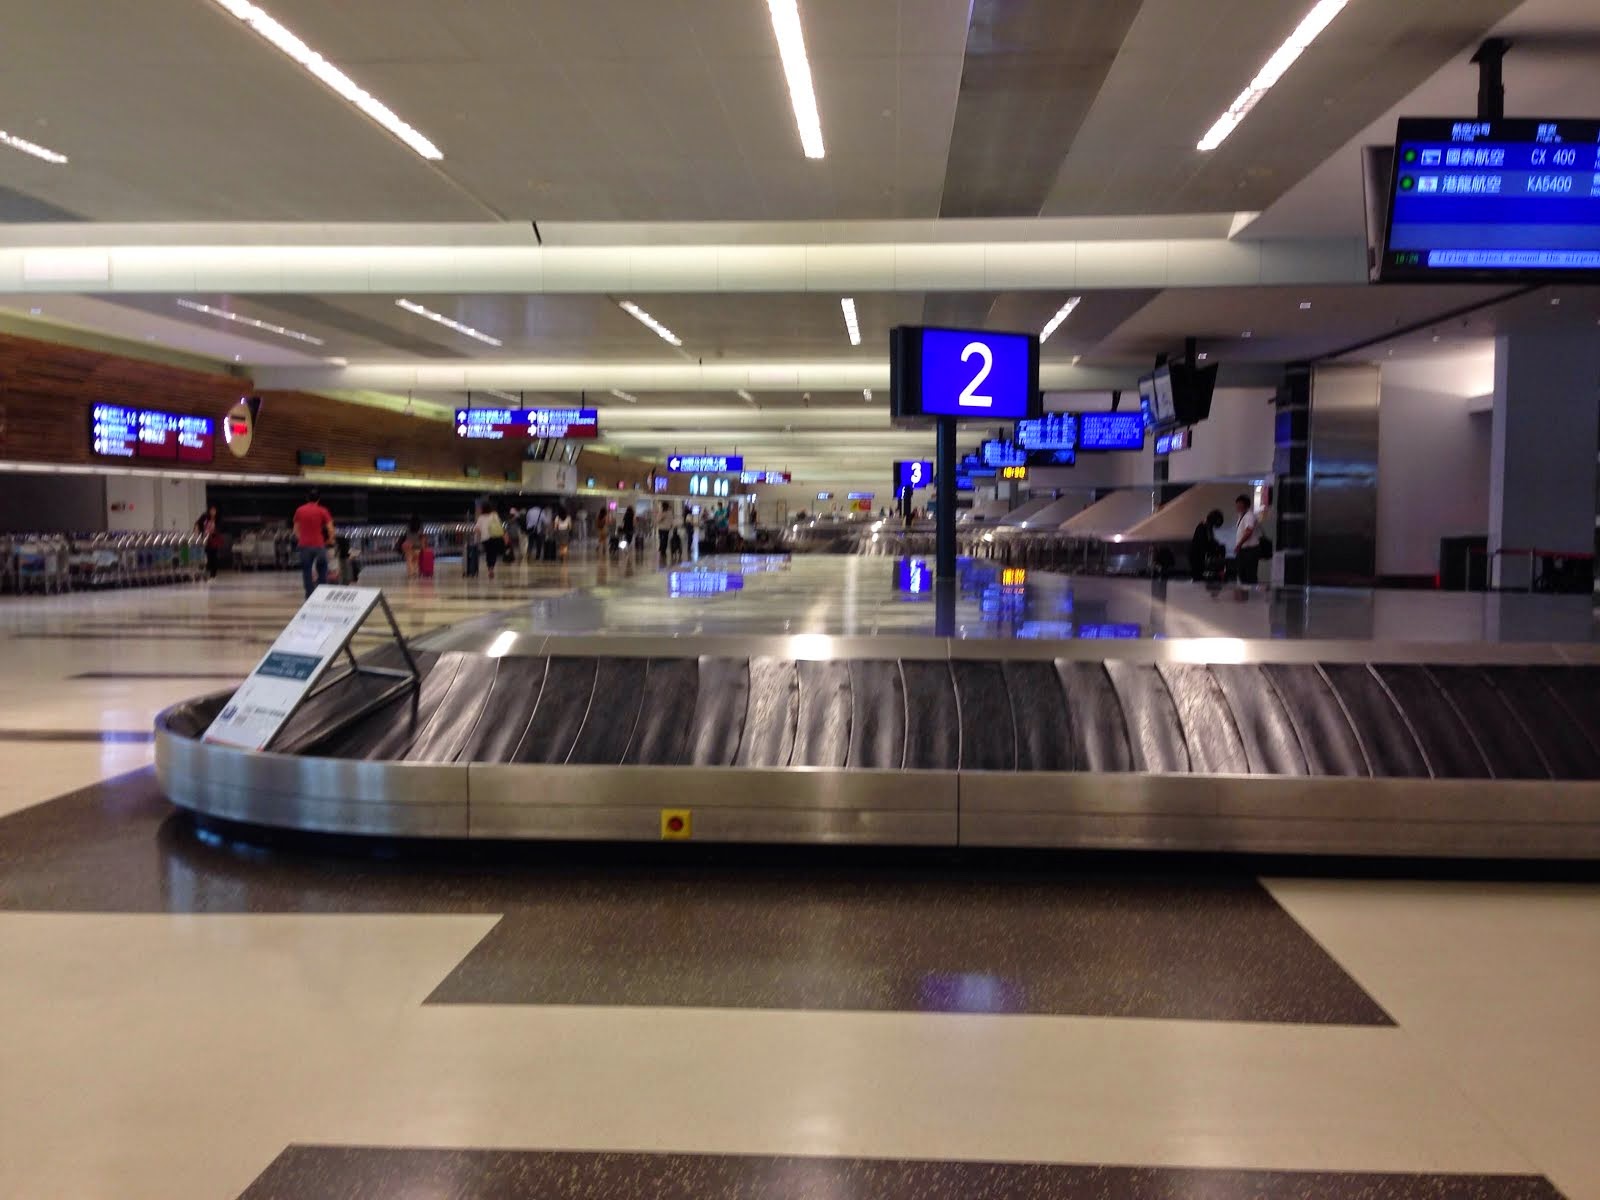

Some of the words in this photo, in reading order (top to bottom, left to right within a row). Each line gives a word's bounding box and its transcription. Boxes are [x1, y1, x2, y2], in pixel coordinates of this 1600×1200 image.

[1531, 148, 1547, 166] CX
[1553, 148, 1576, 166] 400
[959, 342, 993, 407] 2
[911, 462, 922, 484] 3
